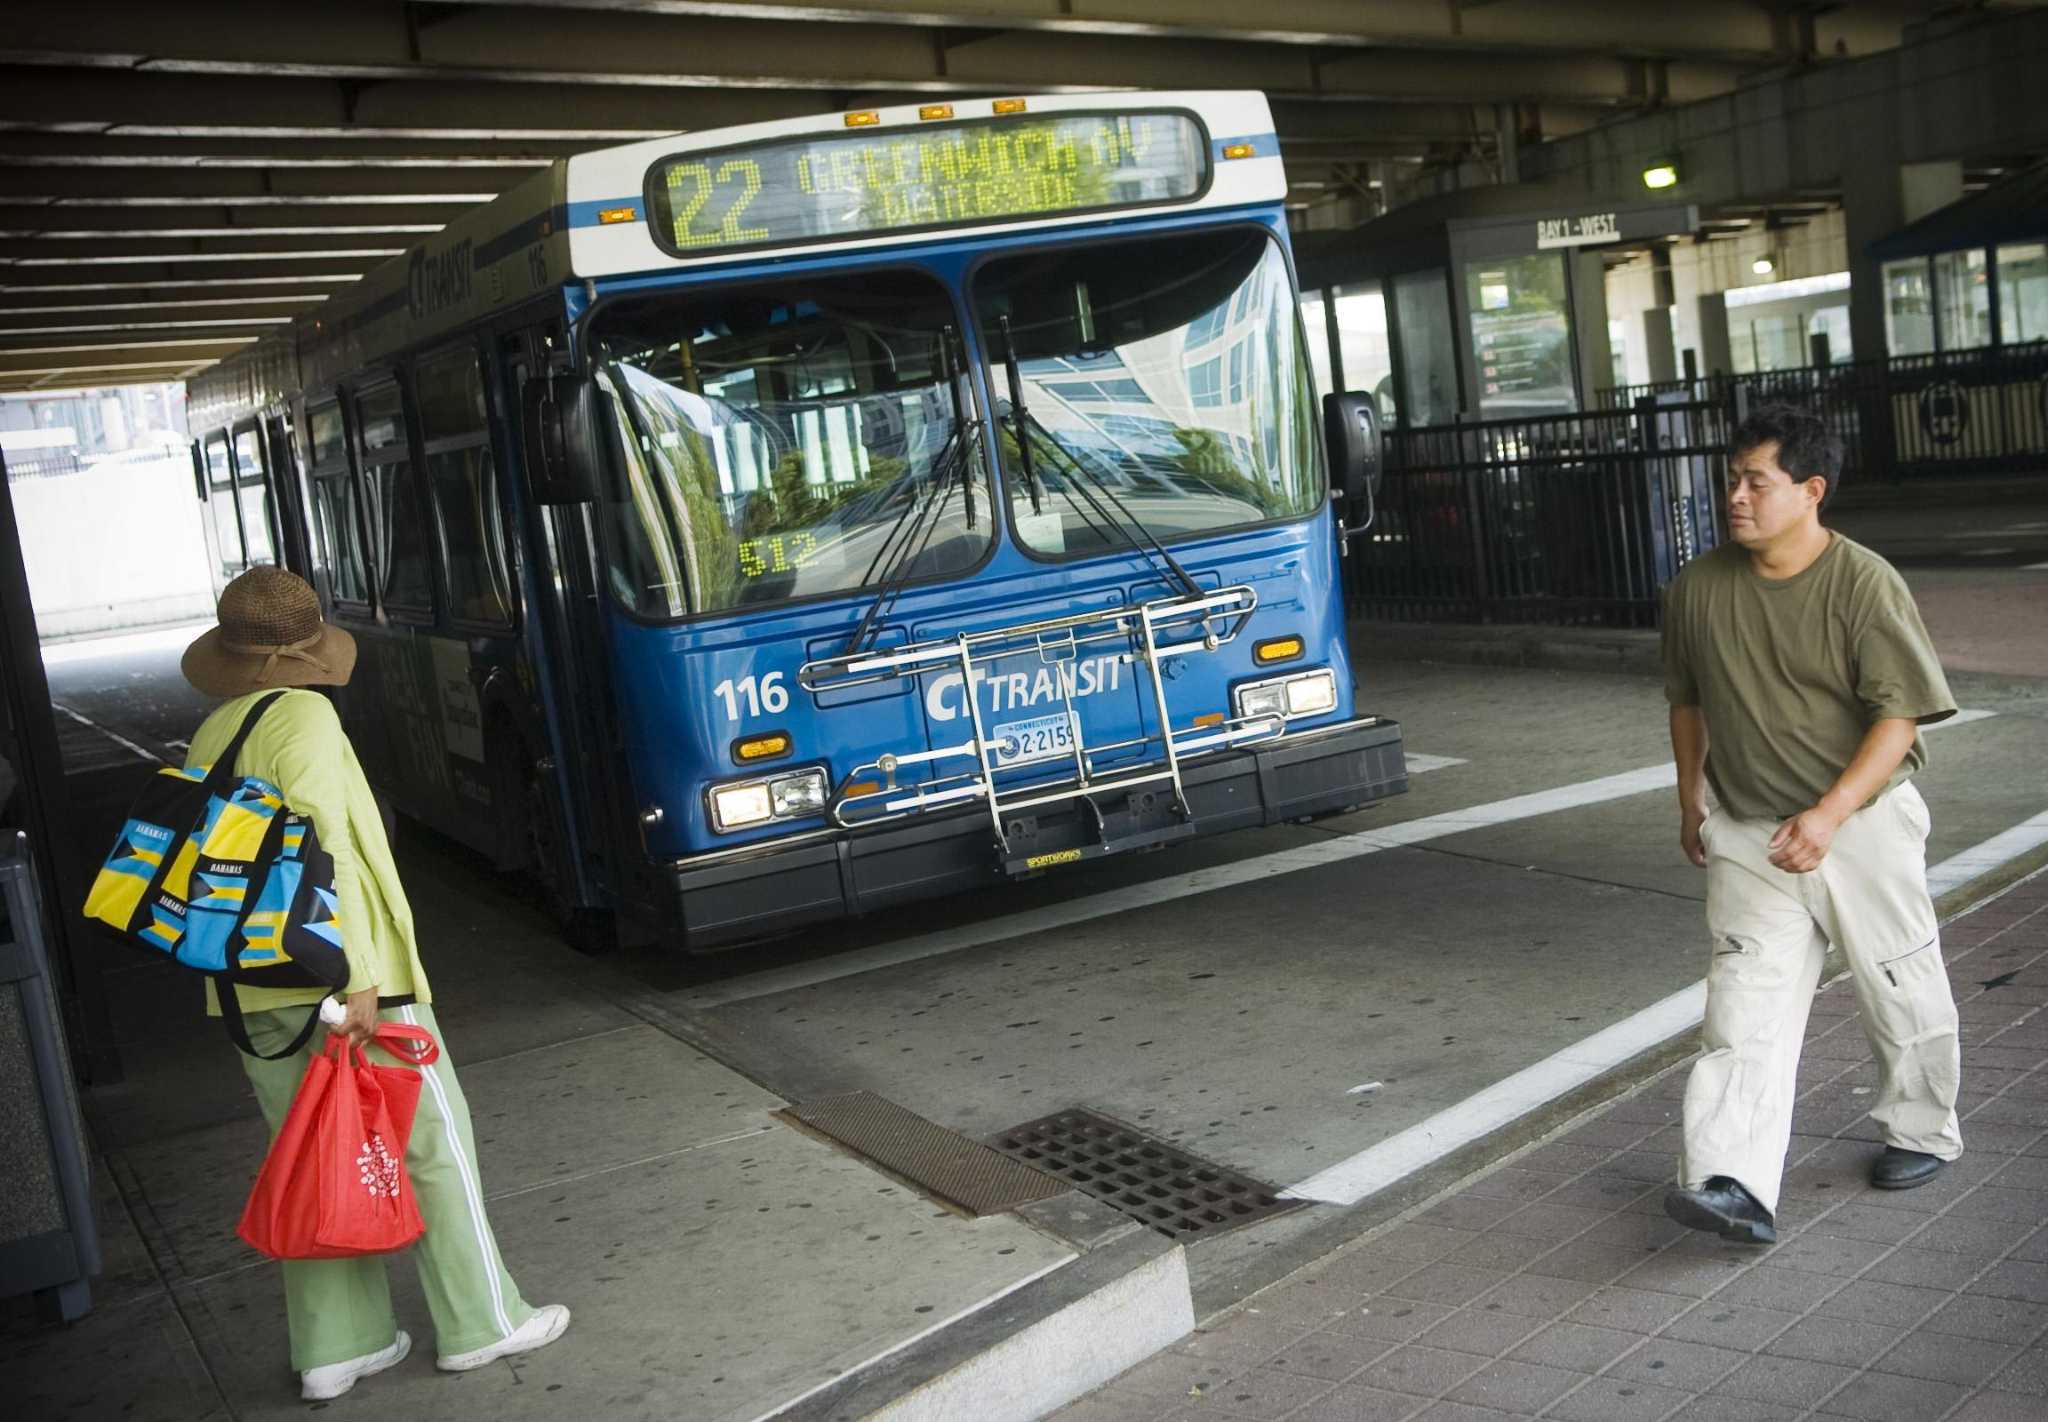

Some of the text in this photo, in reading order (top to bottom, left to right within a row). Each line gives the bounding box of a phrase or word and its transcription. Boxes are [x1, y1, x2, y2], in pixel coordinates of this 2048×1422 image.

[798, 128, 1078, 194] GREENWICH
[667, 160, 768, 248] 22
[1538, 219, 1561, 239] BAY
[1562, 218, 1570, 237] 1
[1580, 213, 1615, 235] WEST
[739, 532, 819, 577] 512
[713, 671, 789, 721] 116
[135, 823, 168, 841] BAHAMAS
[210, 862, 244, 875] BAHAMAS
